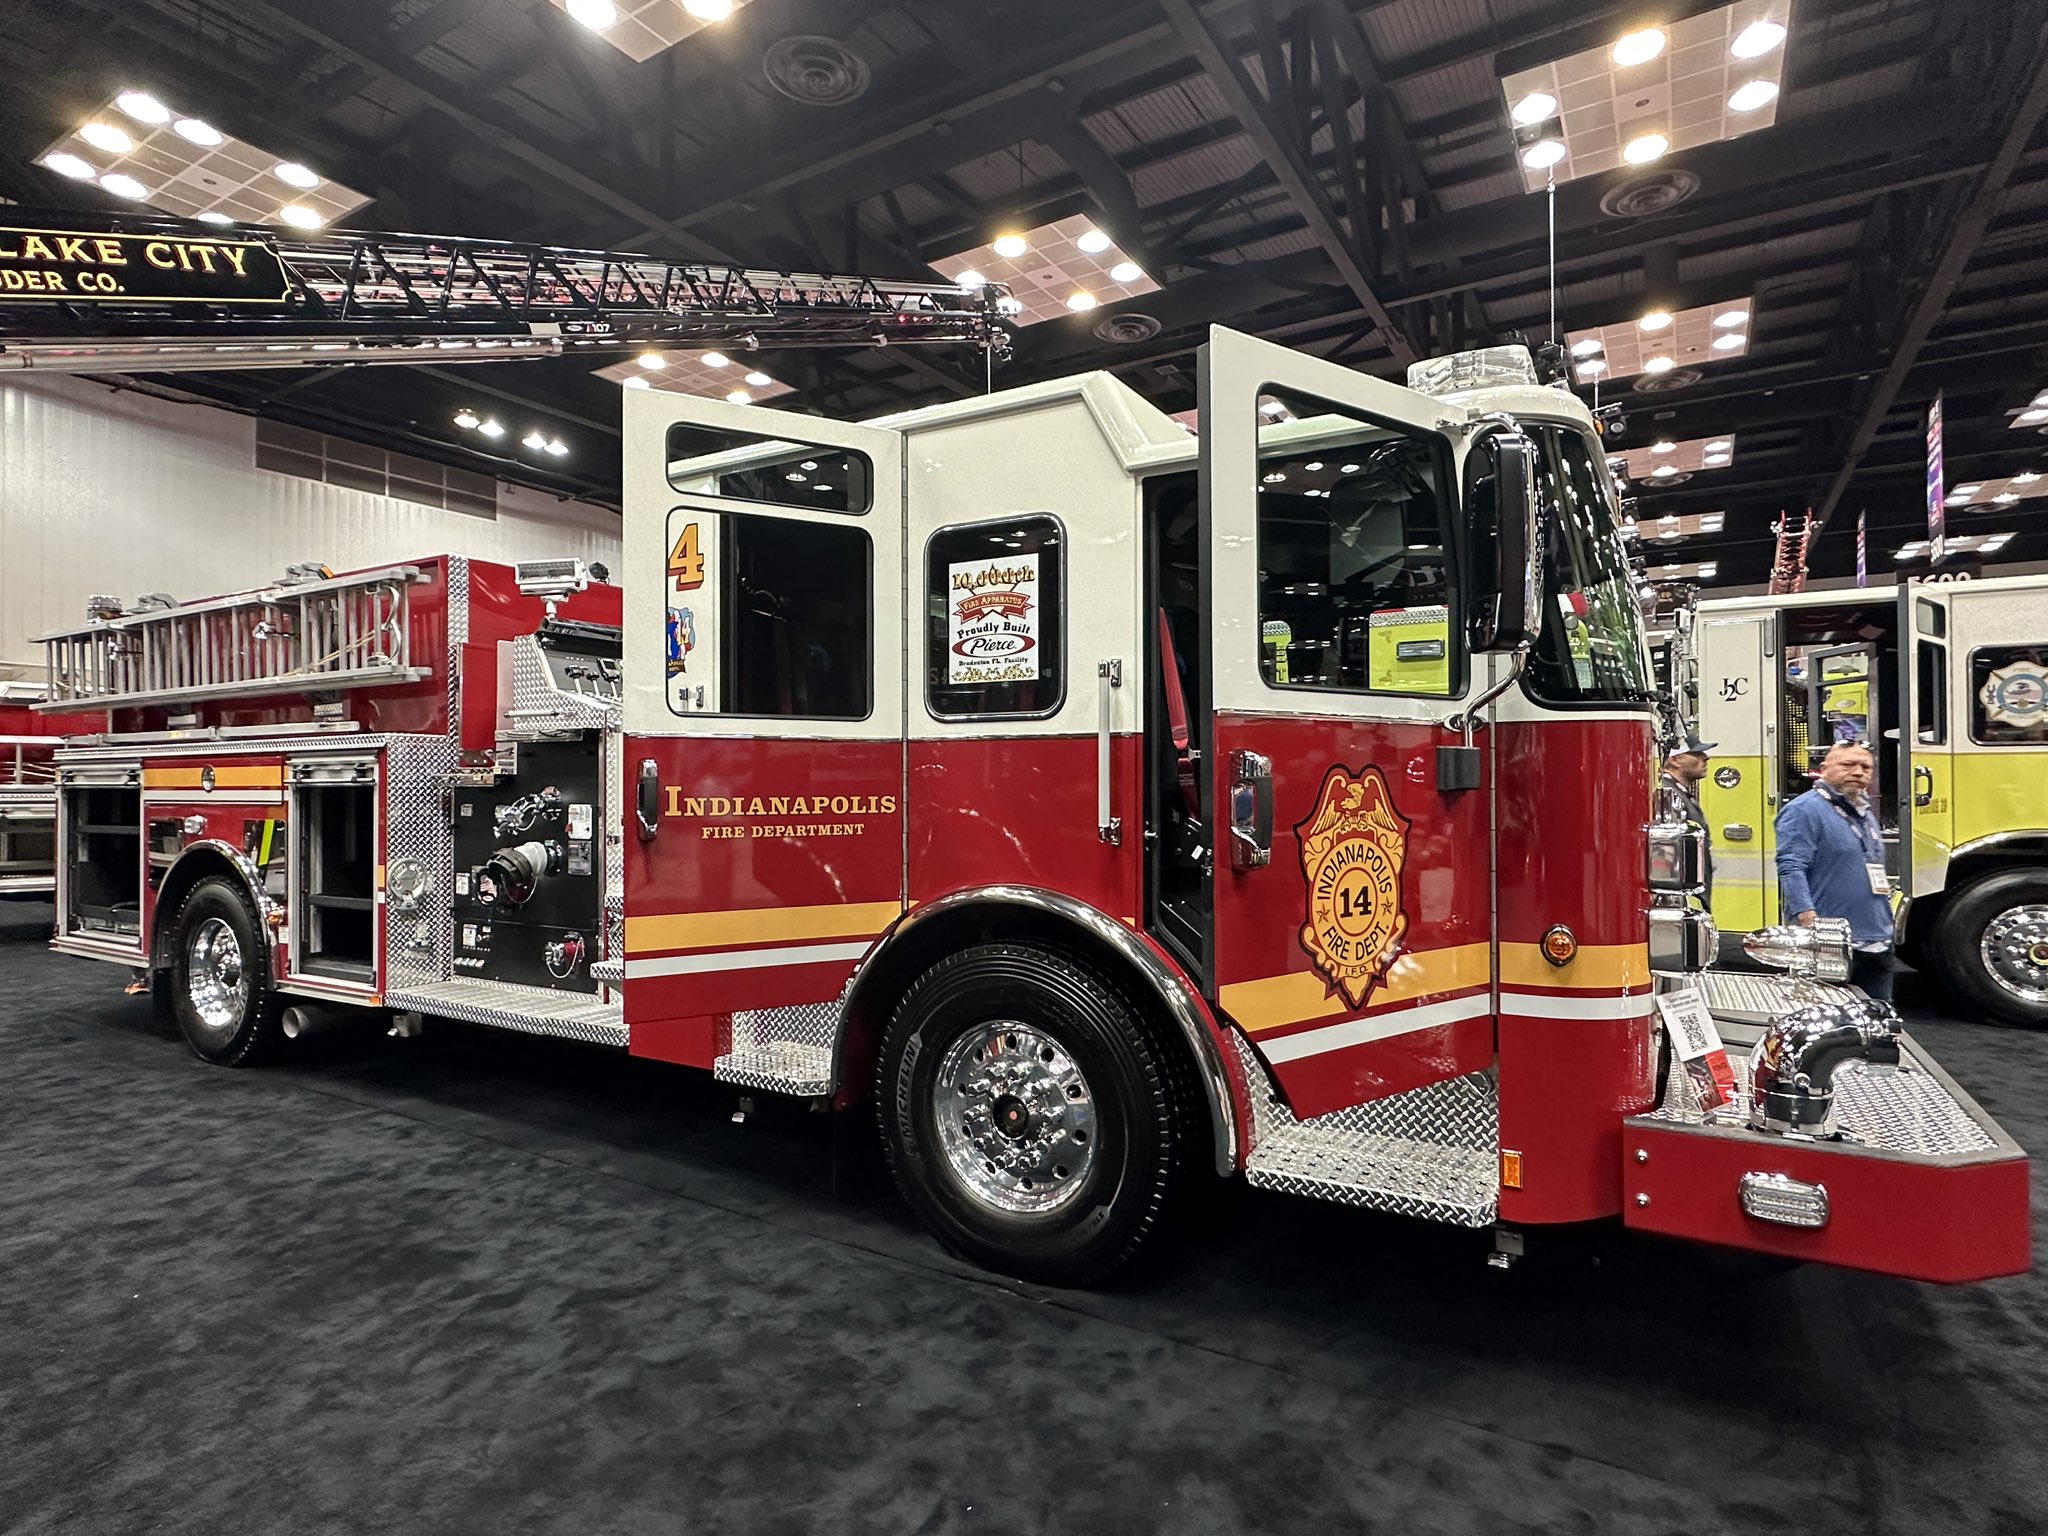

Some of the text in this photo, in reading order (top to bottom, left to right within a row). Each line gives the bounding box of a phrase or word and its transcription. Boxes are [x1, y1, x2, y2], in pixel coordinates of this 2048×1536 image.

[143, 242, 247, 277] CITY
[0, 269, 126, 293] DER CO.
[957, 621, 1031, 640] Proudly Built
[970, 637, 1016, 655] Pierce
[701, 823, 865, 839] FIRE DEPARTMENT
[1317, 843, 1393, 901] INDIANAPOLIS
[1339, 885, 1373, 919] 14
[1322, 920, 1390, 962] FIRE DEPT.
[898, 1043, 916, 1139] MICHELIN
